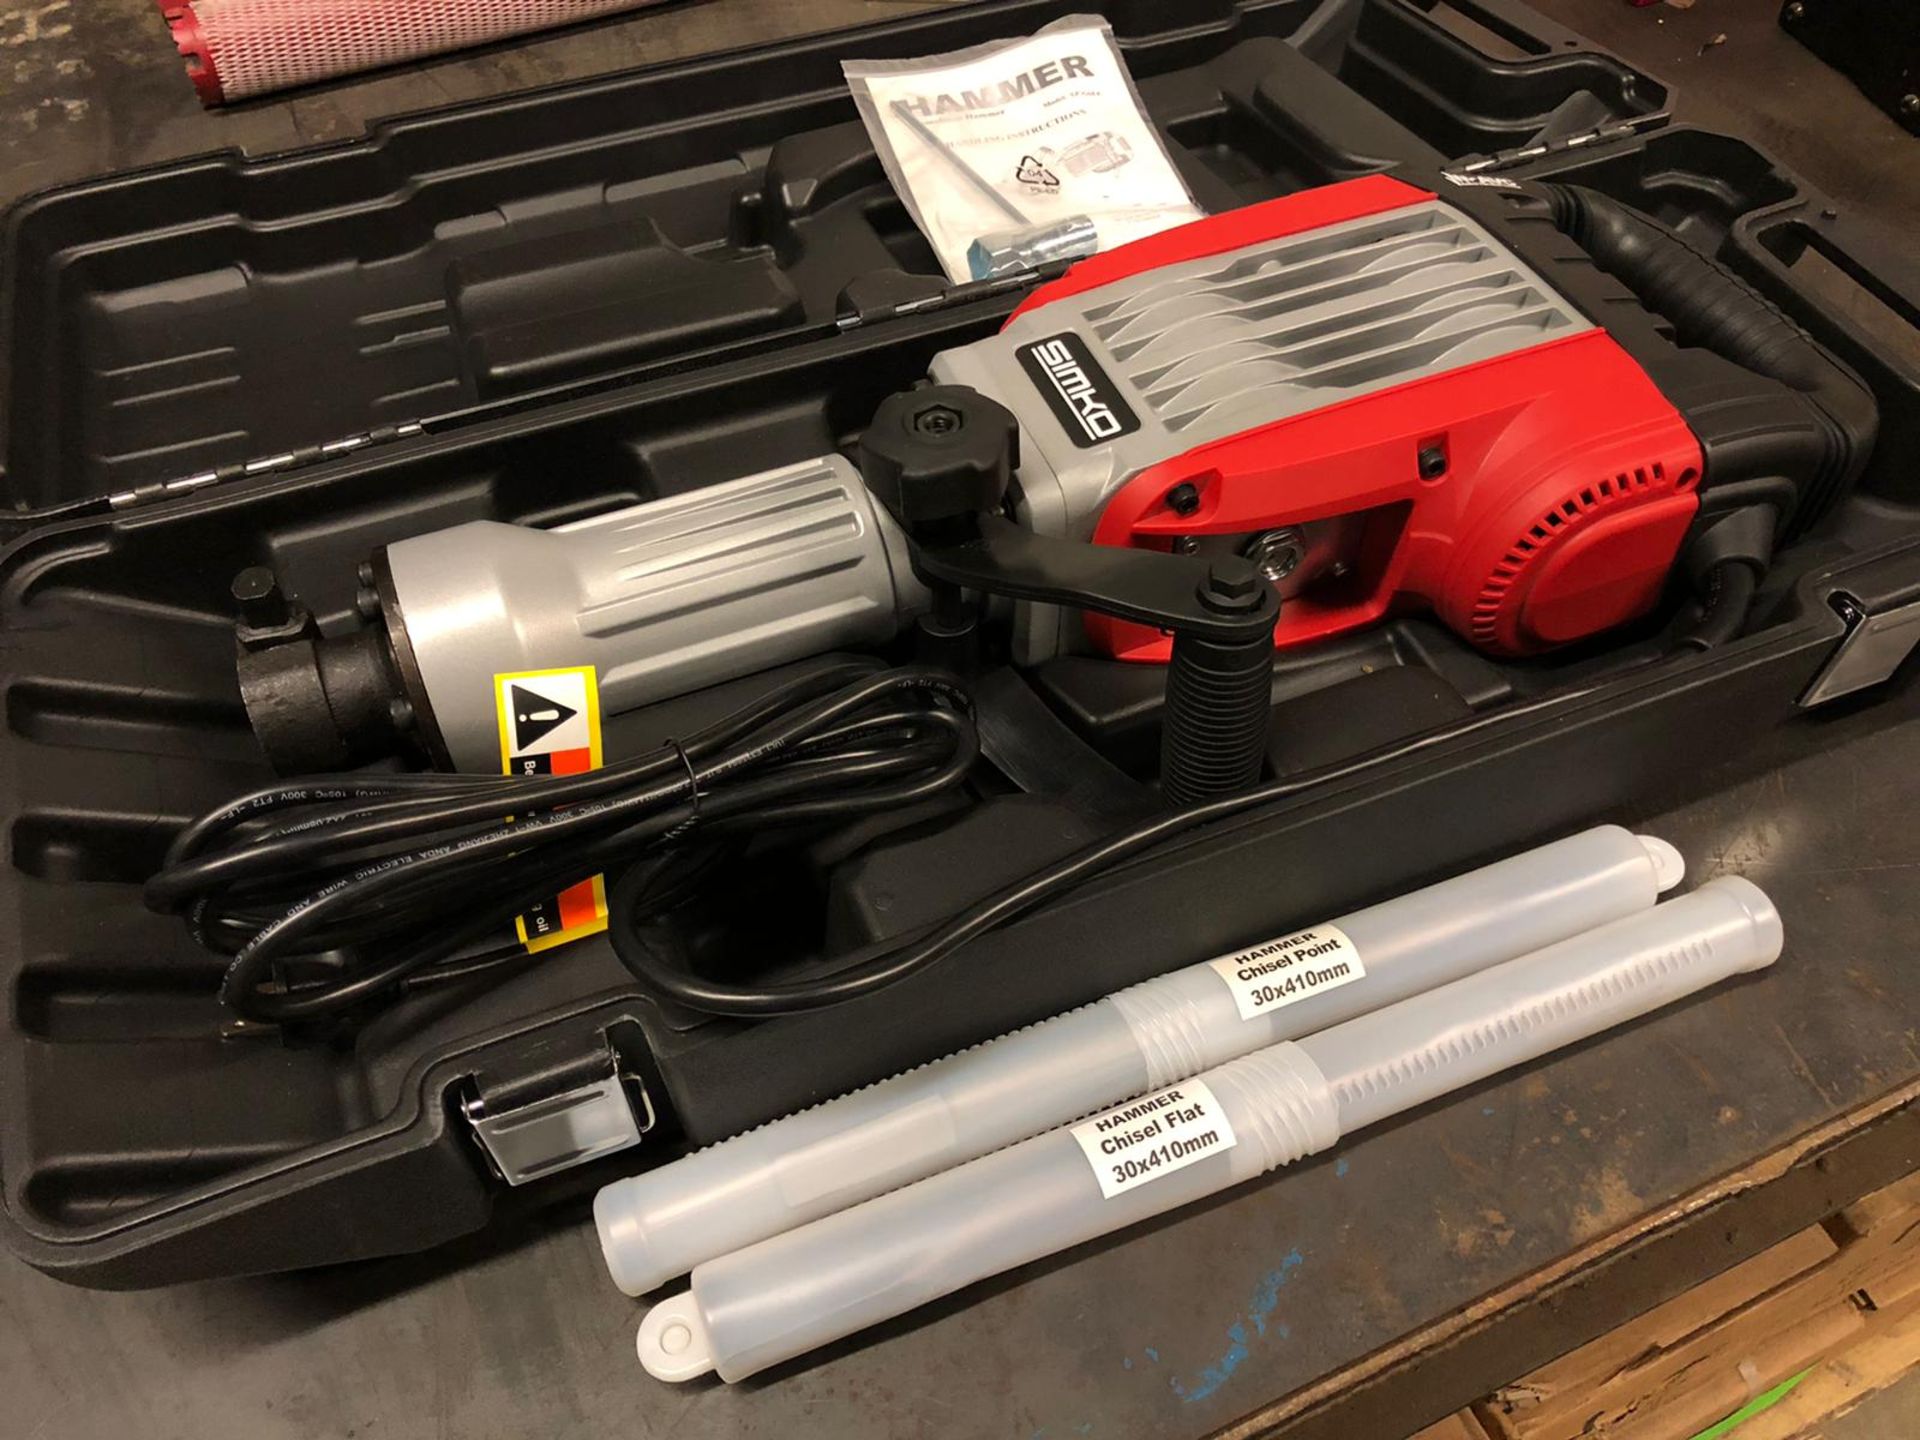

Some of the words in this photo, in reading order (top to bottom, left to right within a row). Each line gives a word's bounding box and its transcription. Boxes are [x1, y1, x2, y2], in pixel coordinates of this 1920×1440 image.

[1036, 339, 1122, 438] SIMKO
[355, 855, 412, 880] ELECTRIC
[419, 845, 450, 859] ANDA
[318, 880, 348, 898] WIRE
[287, 898, 310, 917] AND
[536, 916, 549, 932] oil
[246, 919, 281, 951] CABLE
[1234, 932, 1317, 965] HAMMER
[1237, 955, 1293, 981] Chisel
[1295, 938, 1341, 962] Point
[1251, 962, 1351, 1006] 30x410mm
[1095, 1090, 1184, 1133] HAMMER
[1101, 1120, 1162, 1155] Chisel
[1164, 1103, 1205, 1128] Flat
[1112, 1130, 1219, 1183] 30x410mm
